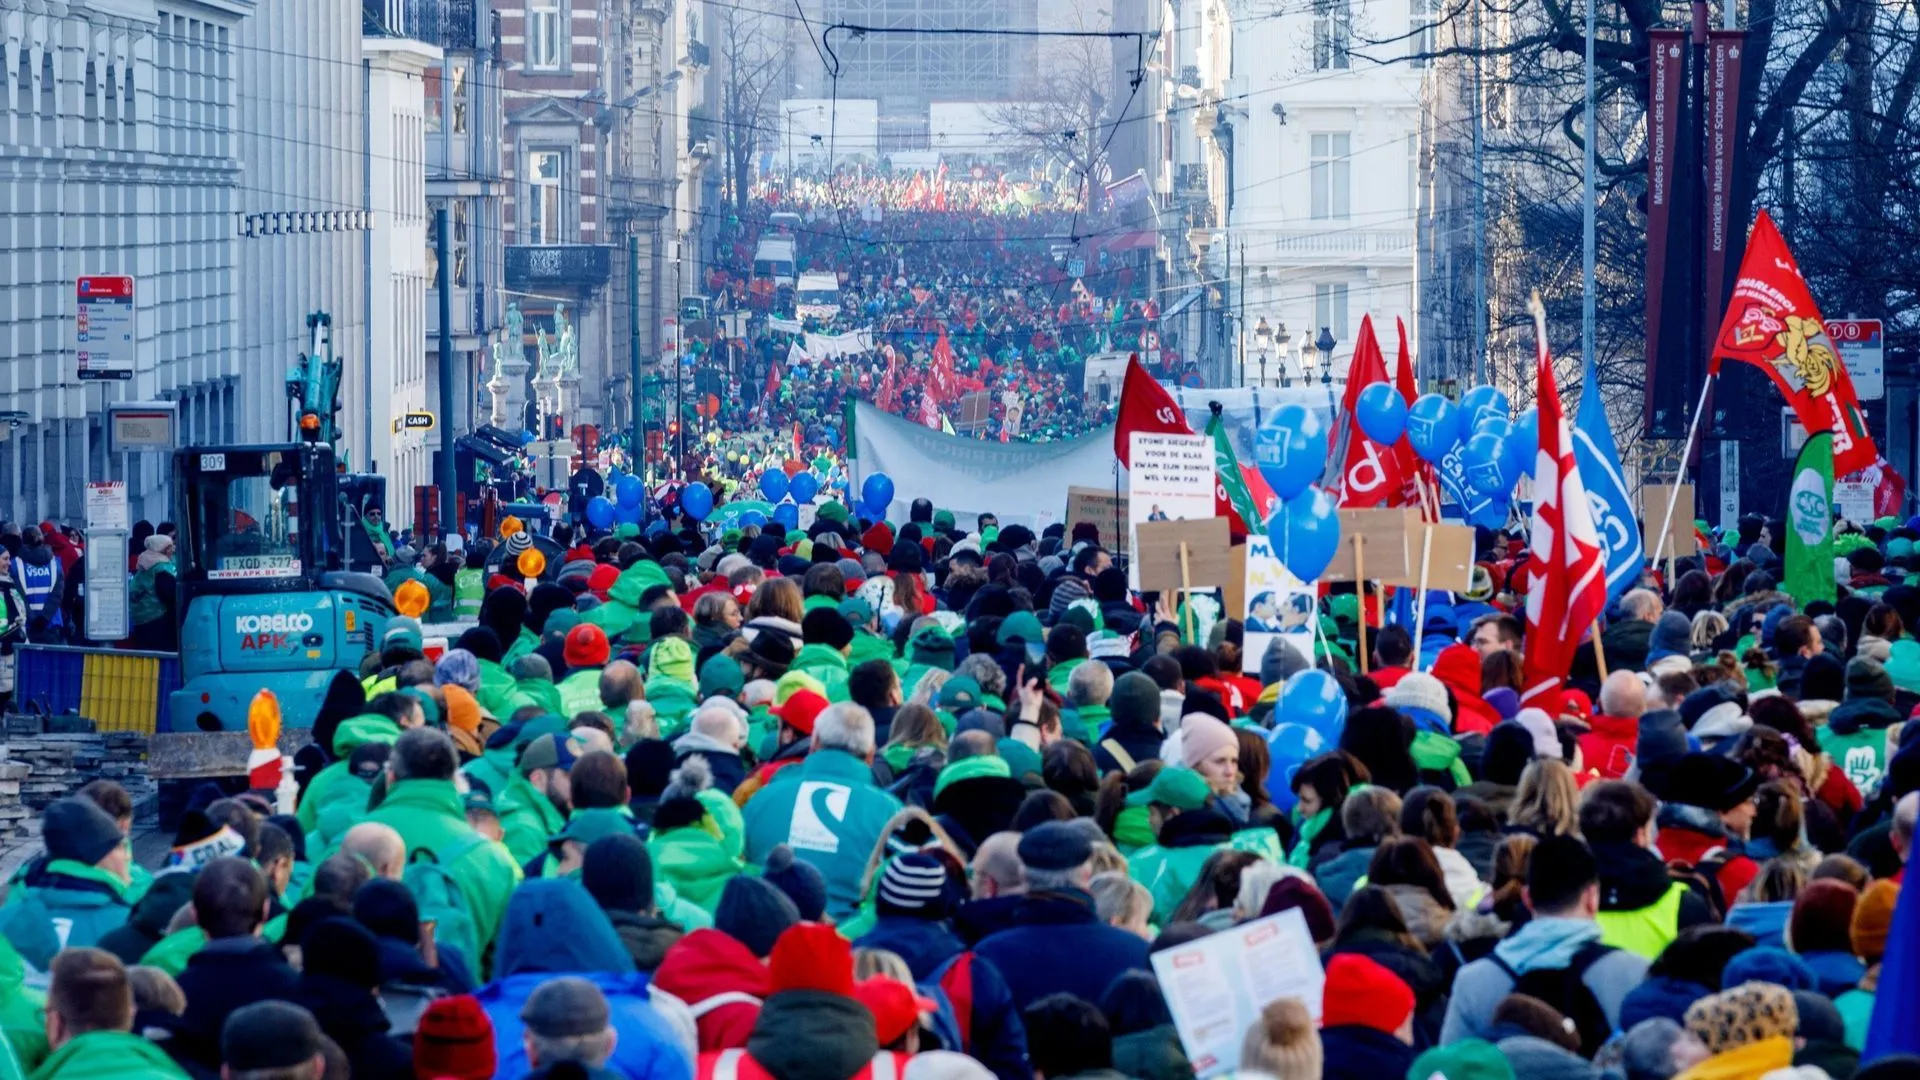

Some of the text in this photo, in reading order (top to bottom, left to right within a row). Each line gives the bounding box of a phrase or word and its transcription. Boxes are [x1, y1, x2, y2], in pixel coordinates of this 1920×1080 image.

[1654, 43, 1665, 205] Musées Royaux des Beaux-Arts
[1713, 44, 1725, 251] Koninklijke Musea voor Schone Kunsten
[201, 455, 223, 469] 309
[26, 567, 50, 577] VSOA
[236, 613, 313, 633] KOBELCO
[241, 632, 289, 650] APK
